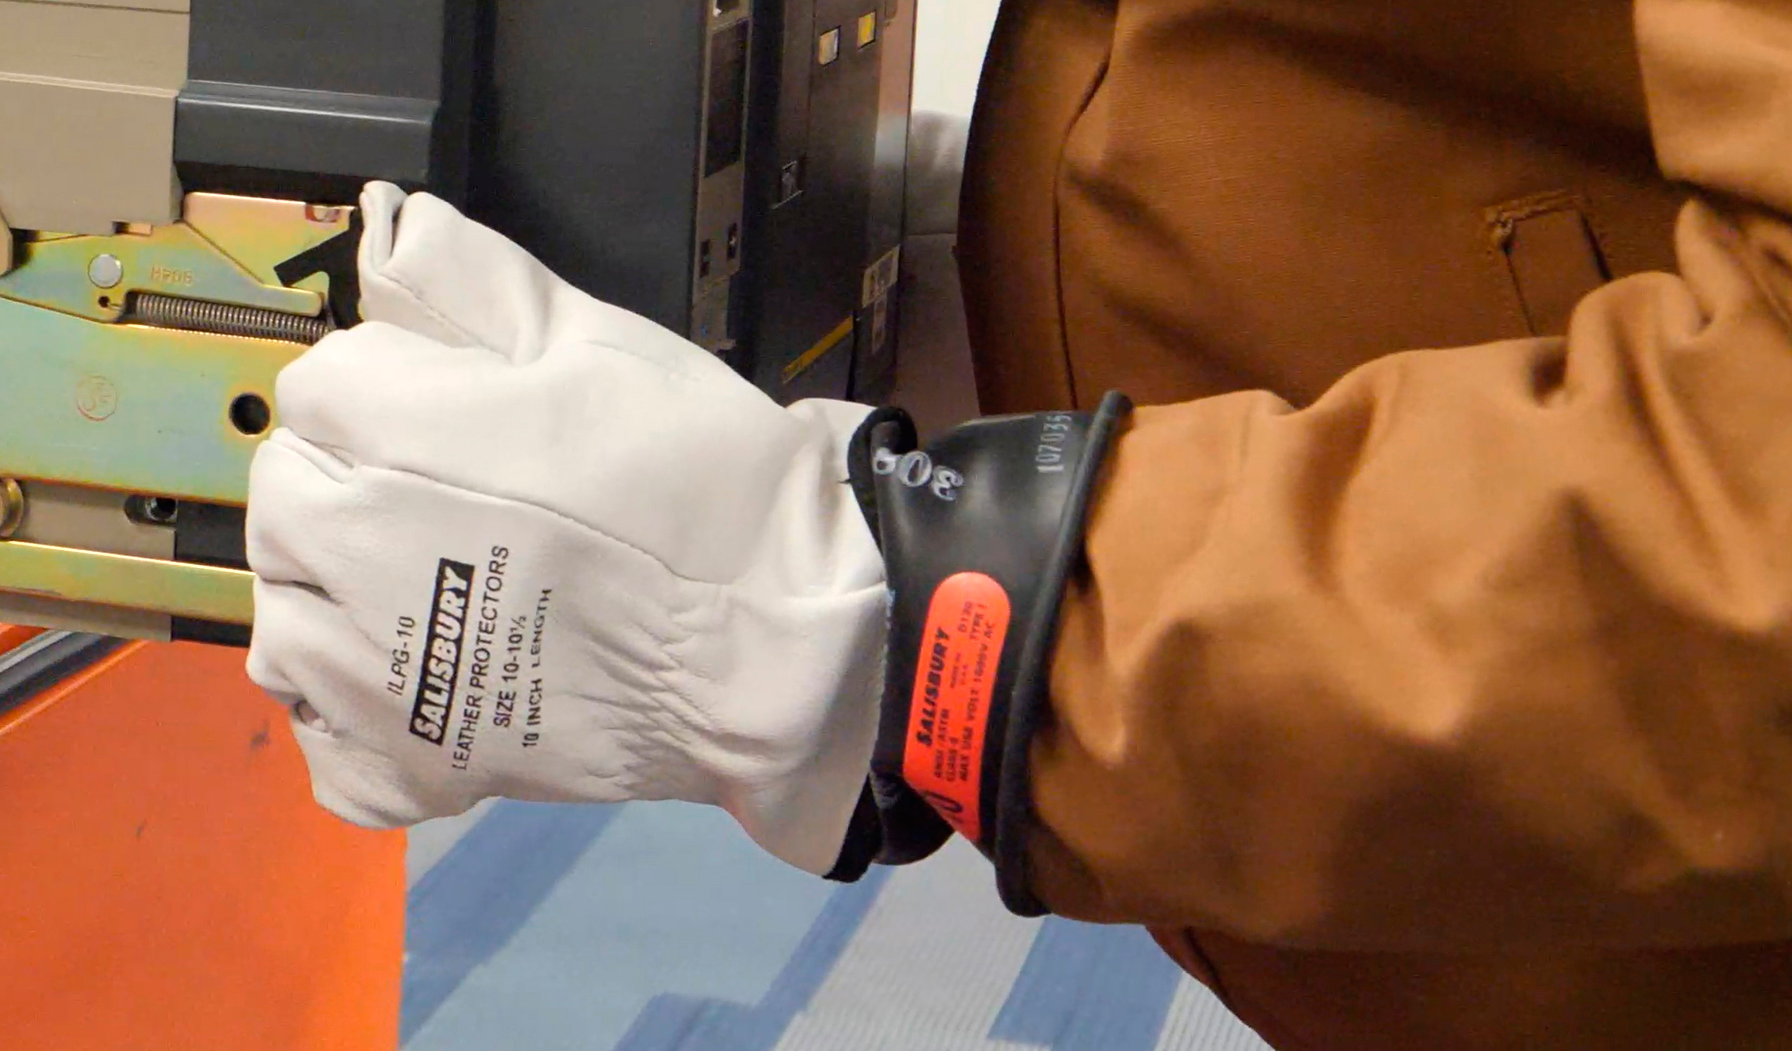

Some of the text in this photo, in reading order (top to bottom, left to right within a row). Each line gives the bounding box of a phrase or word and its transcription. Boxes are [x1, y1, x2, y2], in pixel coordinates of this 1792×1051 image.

[413, 566, 468, 741] SALISBURY
[453, 545, 509, 770] LEATHER PROTECTORS
[493, 691, 517, 728] SIZE
[523, 588, 552, 748] 10 INCH LENGTH
[916, 628, 950, 747] SALISBURY
